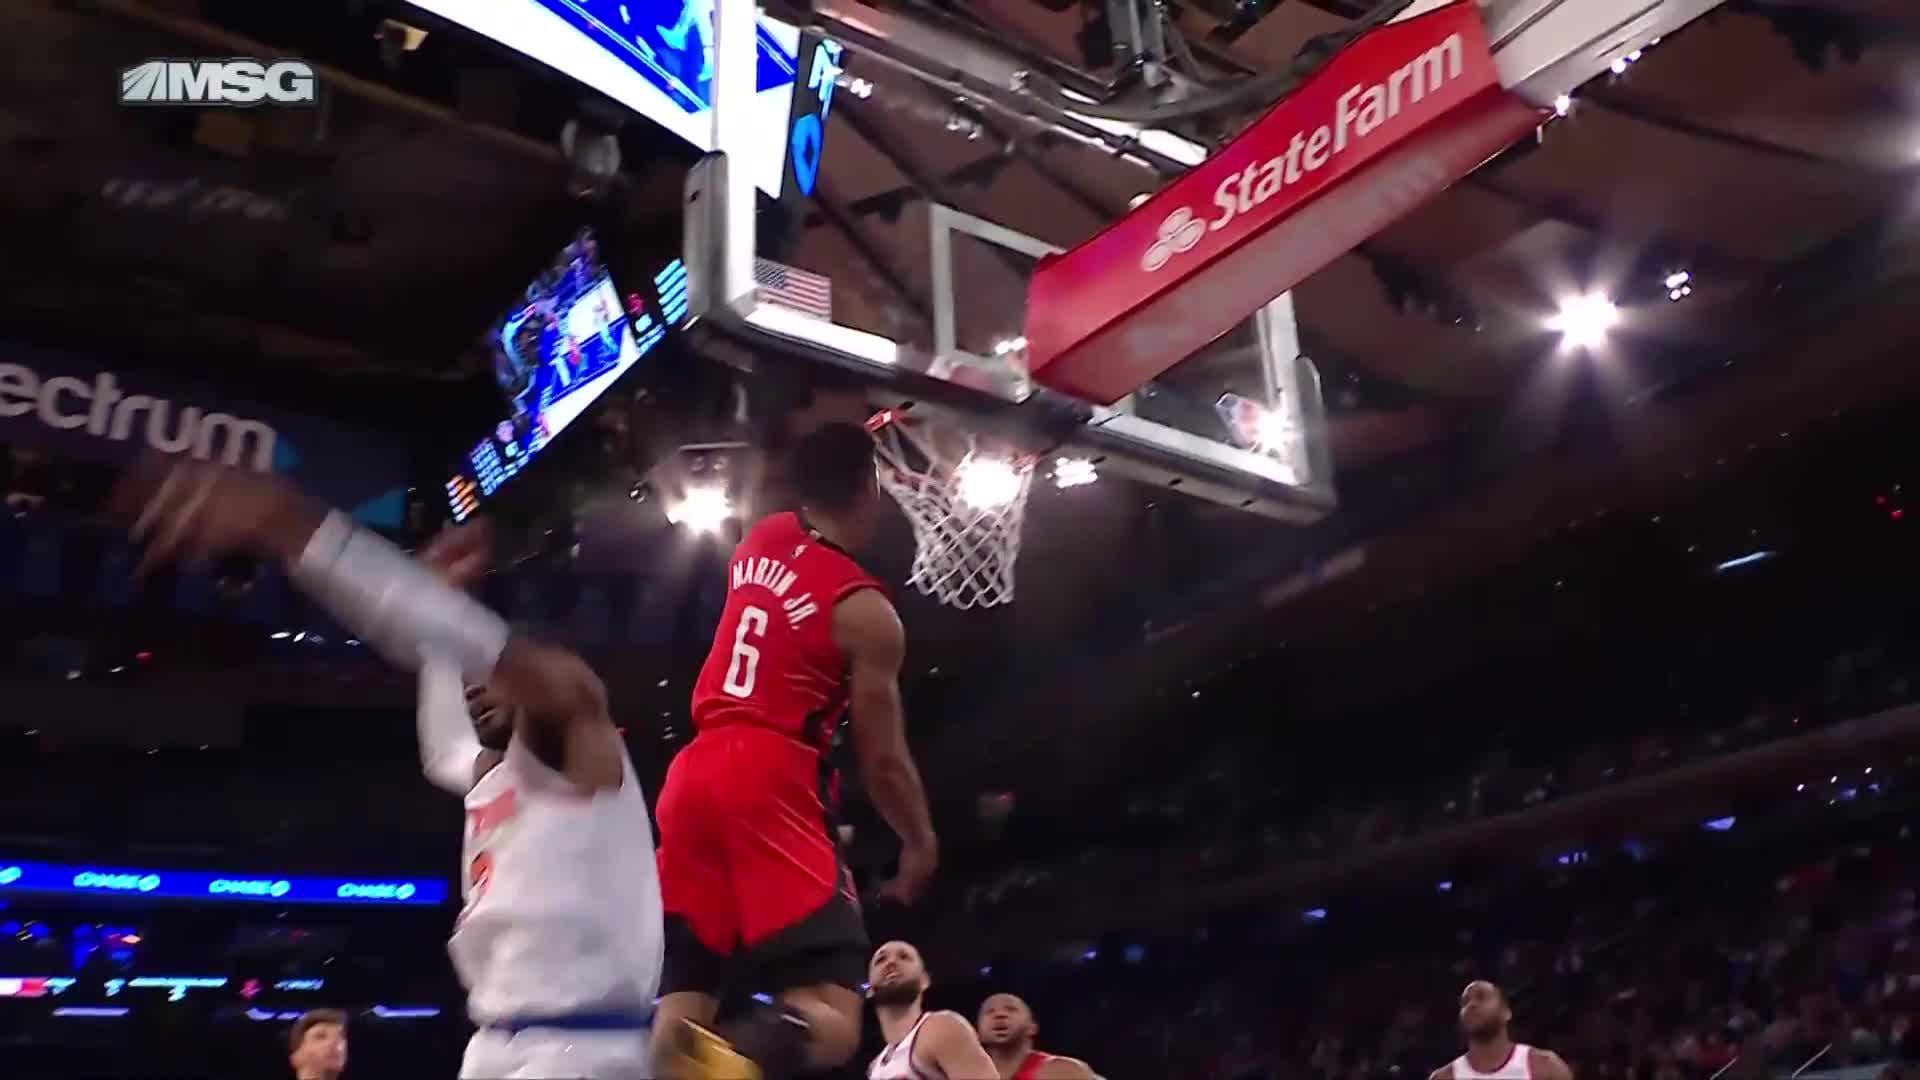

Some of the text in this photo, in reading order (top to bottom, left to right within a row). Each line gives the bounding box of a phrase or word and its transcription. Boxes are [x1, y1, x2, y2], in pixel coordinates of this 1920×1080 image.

[0, 362, 277, 473] ectrum
[732, 556, 818, 630] MARTIN JR.
[722, 605, 769, 698] 6
